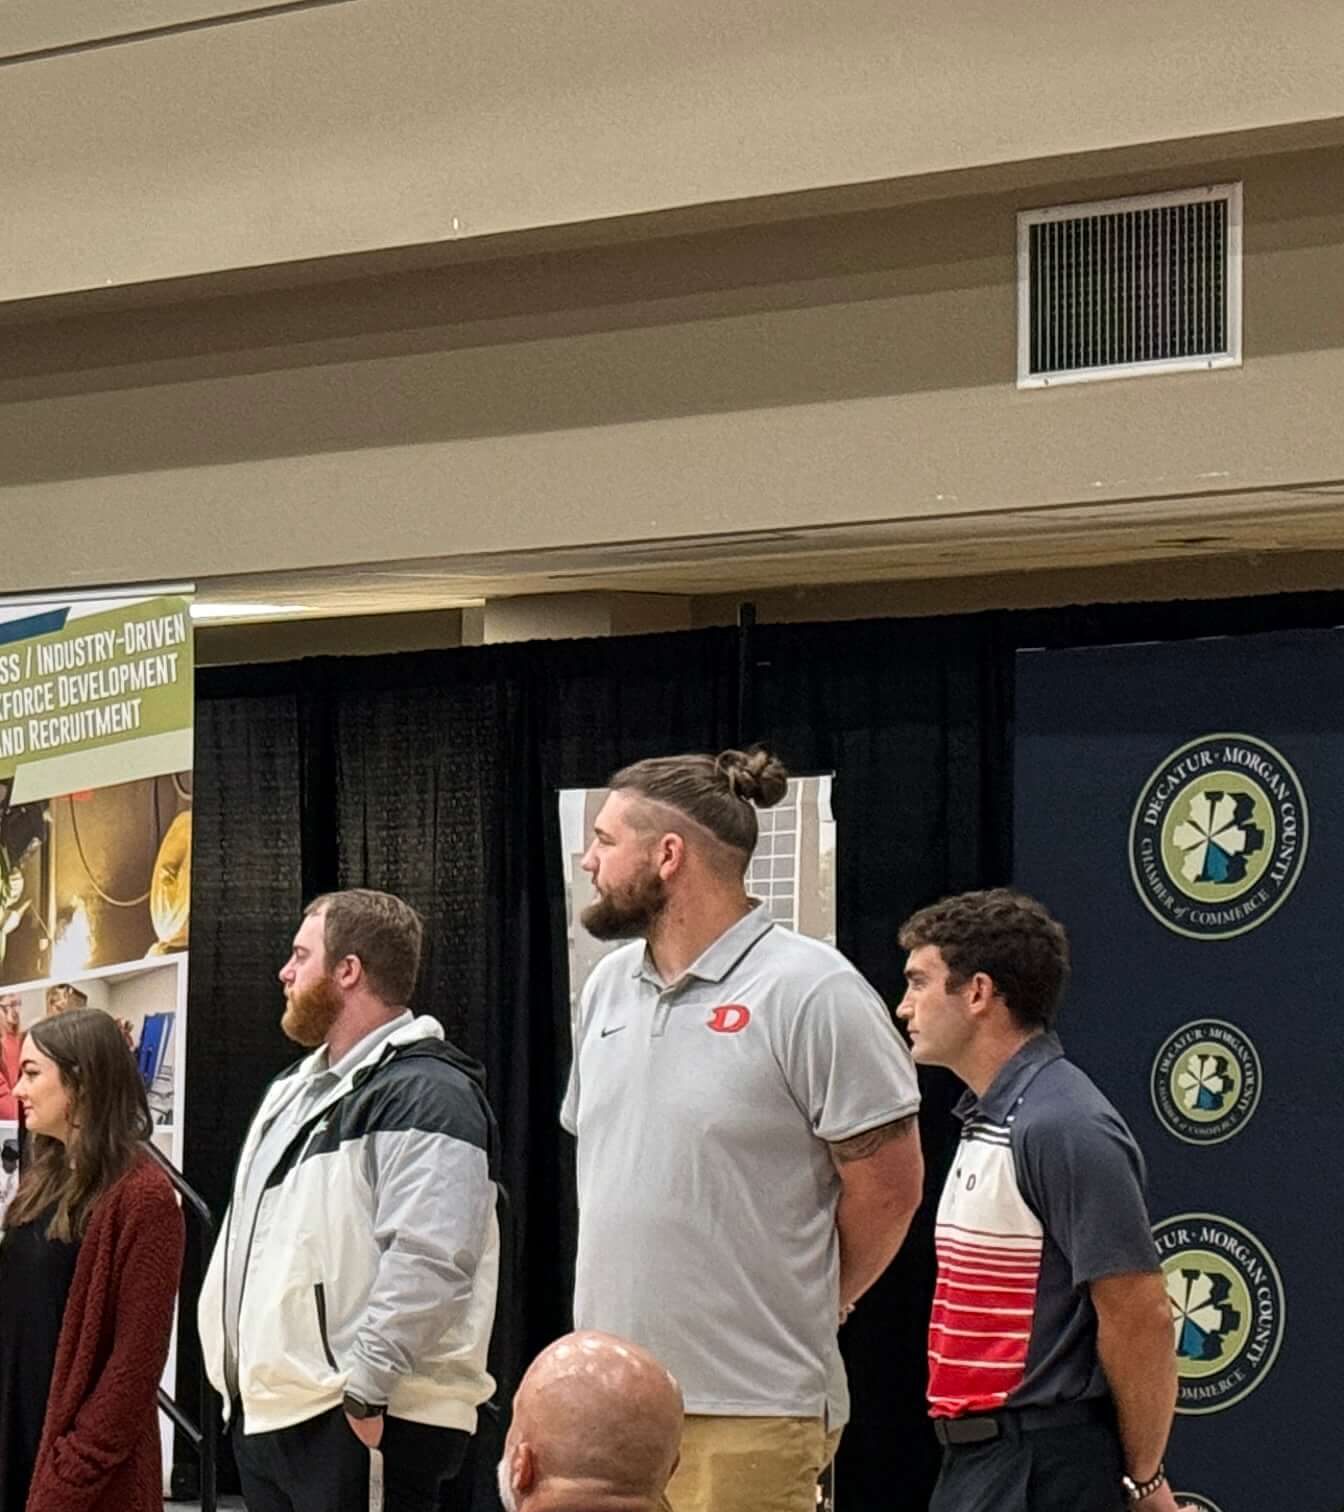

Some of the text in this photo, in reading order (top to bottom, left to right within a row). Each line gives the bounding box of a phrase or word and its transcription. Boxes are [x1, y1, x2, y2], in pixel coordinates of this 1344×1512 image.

[25, 647, 33, 678] /
[37, 614, 186, 674] INDUSTRY-DRIVEN
[58, 652, 178, 709] DEVELOPMENT
[28, 699, 142, 750] RECRUITMENT
[1144, 747, 1297, 888] DECATUR MORGAN COUNTY
[1141, 838, 1175, 910] CHAMBER
[1189, 888, 1270, 925] COMMERCE
[708, 1004, 750, 1033] D
[1199, 1227, 1274, 1368] MORGAN COUNTY
[1178, 1368, 1246, 1400] OMMERCE
